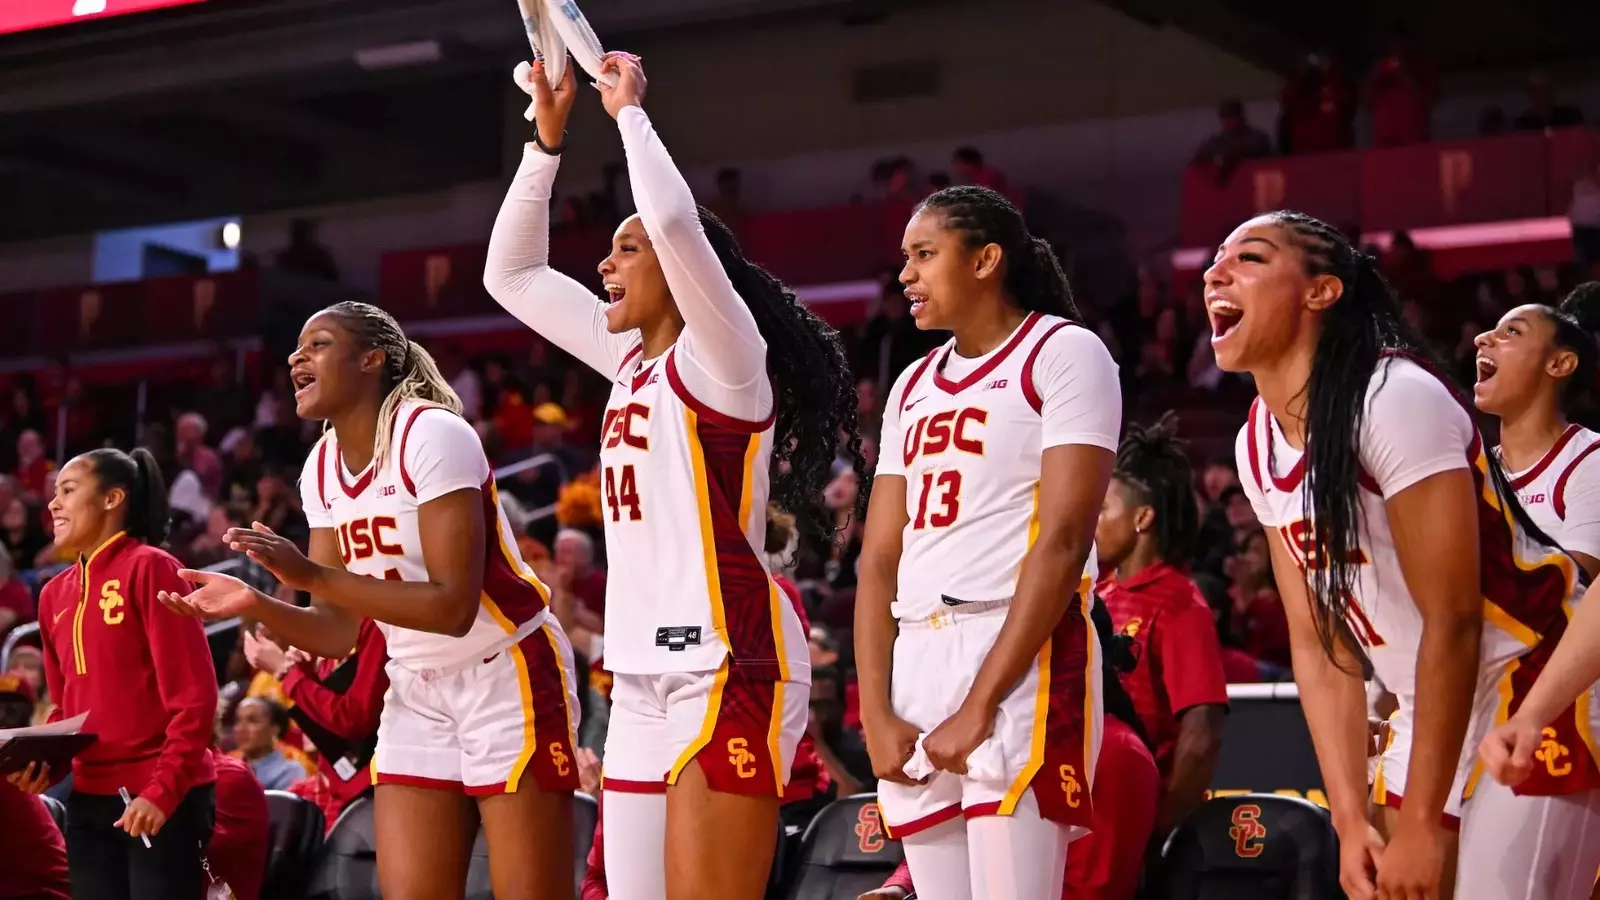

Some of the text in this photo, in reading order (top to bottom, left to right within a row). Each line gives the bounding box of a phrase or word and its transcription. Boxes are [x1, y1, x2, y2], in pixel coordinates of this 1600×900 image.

[601, 402, 651, 452] USC
[903, 407, 988, 468] USC
[604, 464, 642, 522] 44
[914, 469, 962, 530] 13
[335, 516, 405, 566] USC
[98, 578, 125, 626] SC
[549, 741, 570, 777] SC
[727, 737, 757, 779] SC
[1535, 726, 1573, 777] SC
[1059, 764, 1082, 808] SC
[1229, 804, 1267, 858] SC
